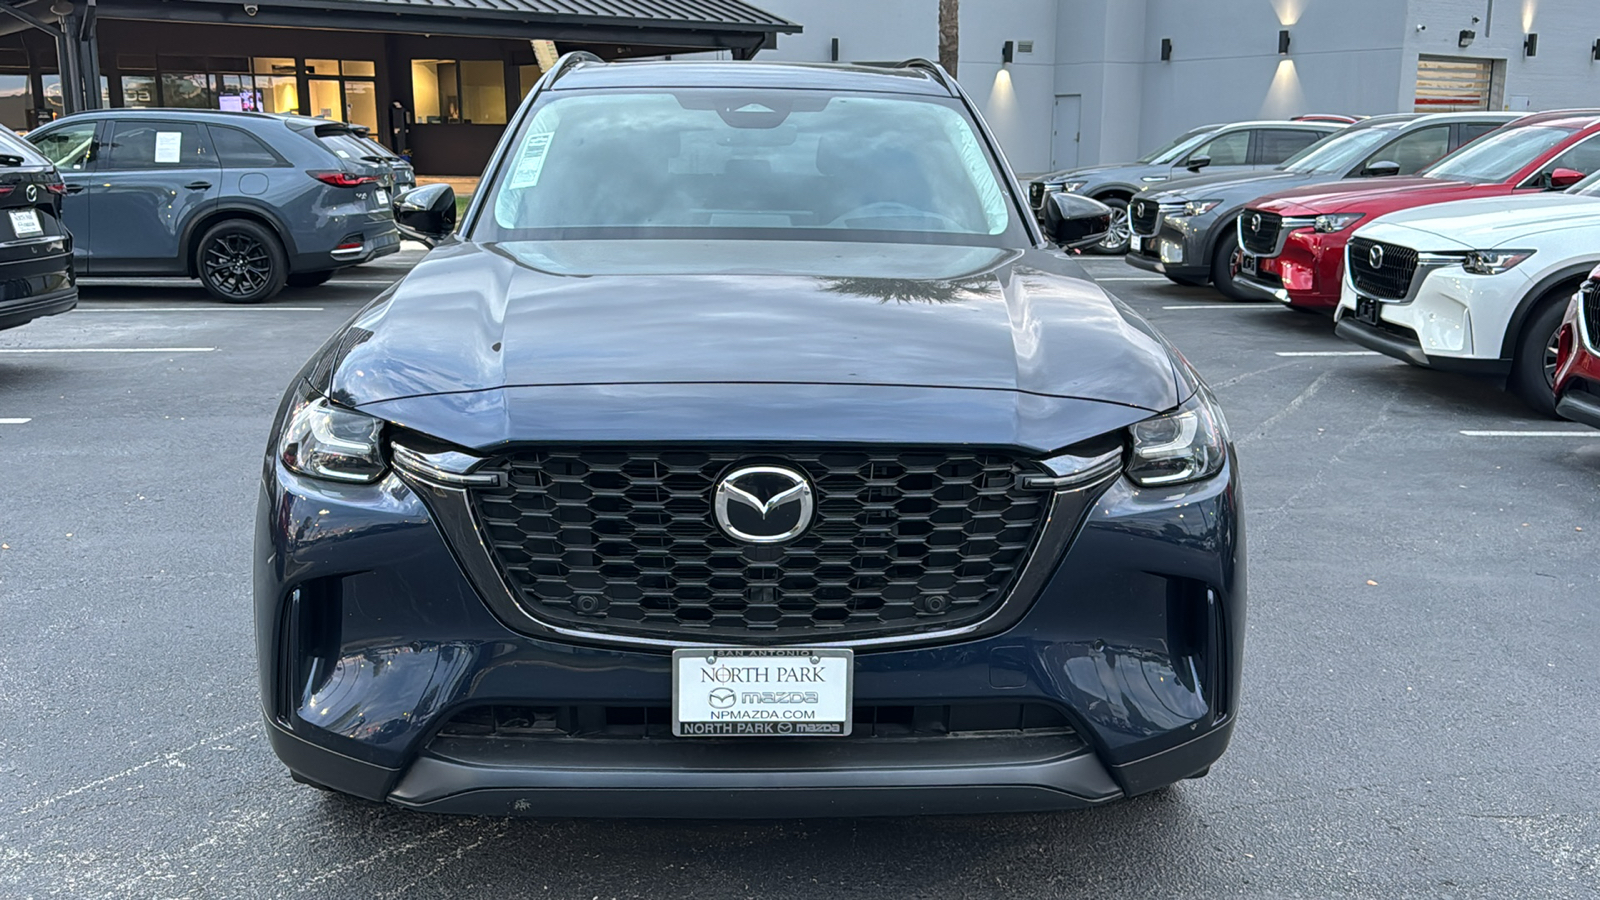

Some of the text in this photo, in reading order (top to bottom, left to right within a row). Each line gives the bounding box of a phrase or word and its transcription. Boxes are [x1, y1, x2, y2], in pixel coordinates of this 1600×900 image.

[700, 666, 826, 683] NORTH PARK
[742, 692, 819, 704] mazda
[711, 710, 815, 720] NPMAZDA.COM
[684, 723, 840, 734] NORTH PARK mazda
